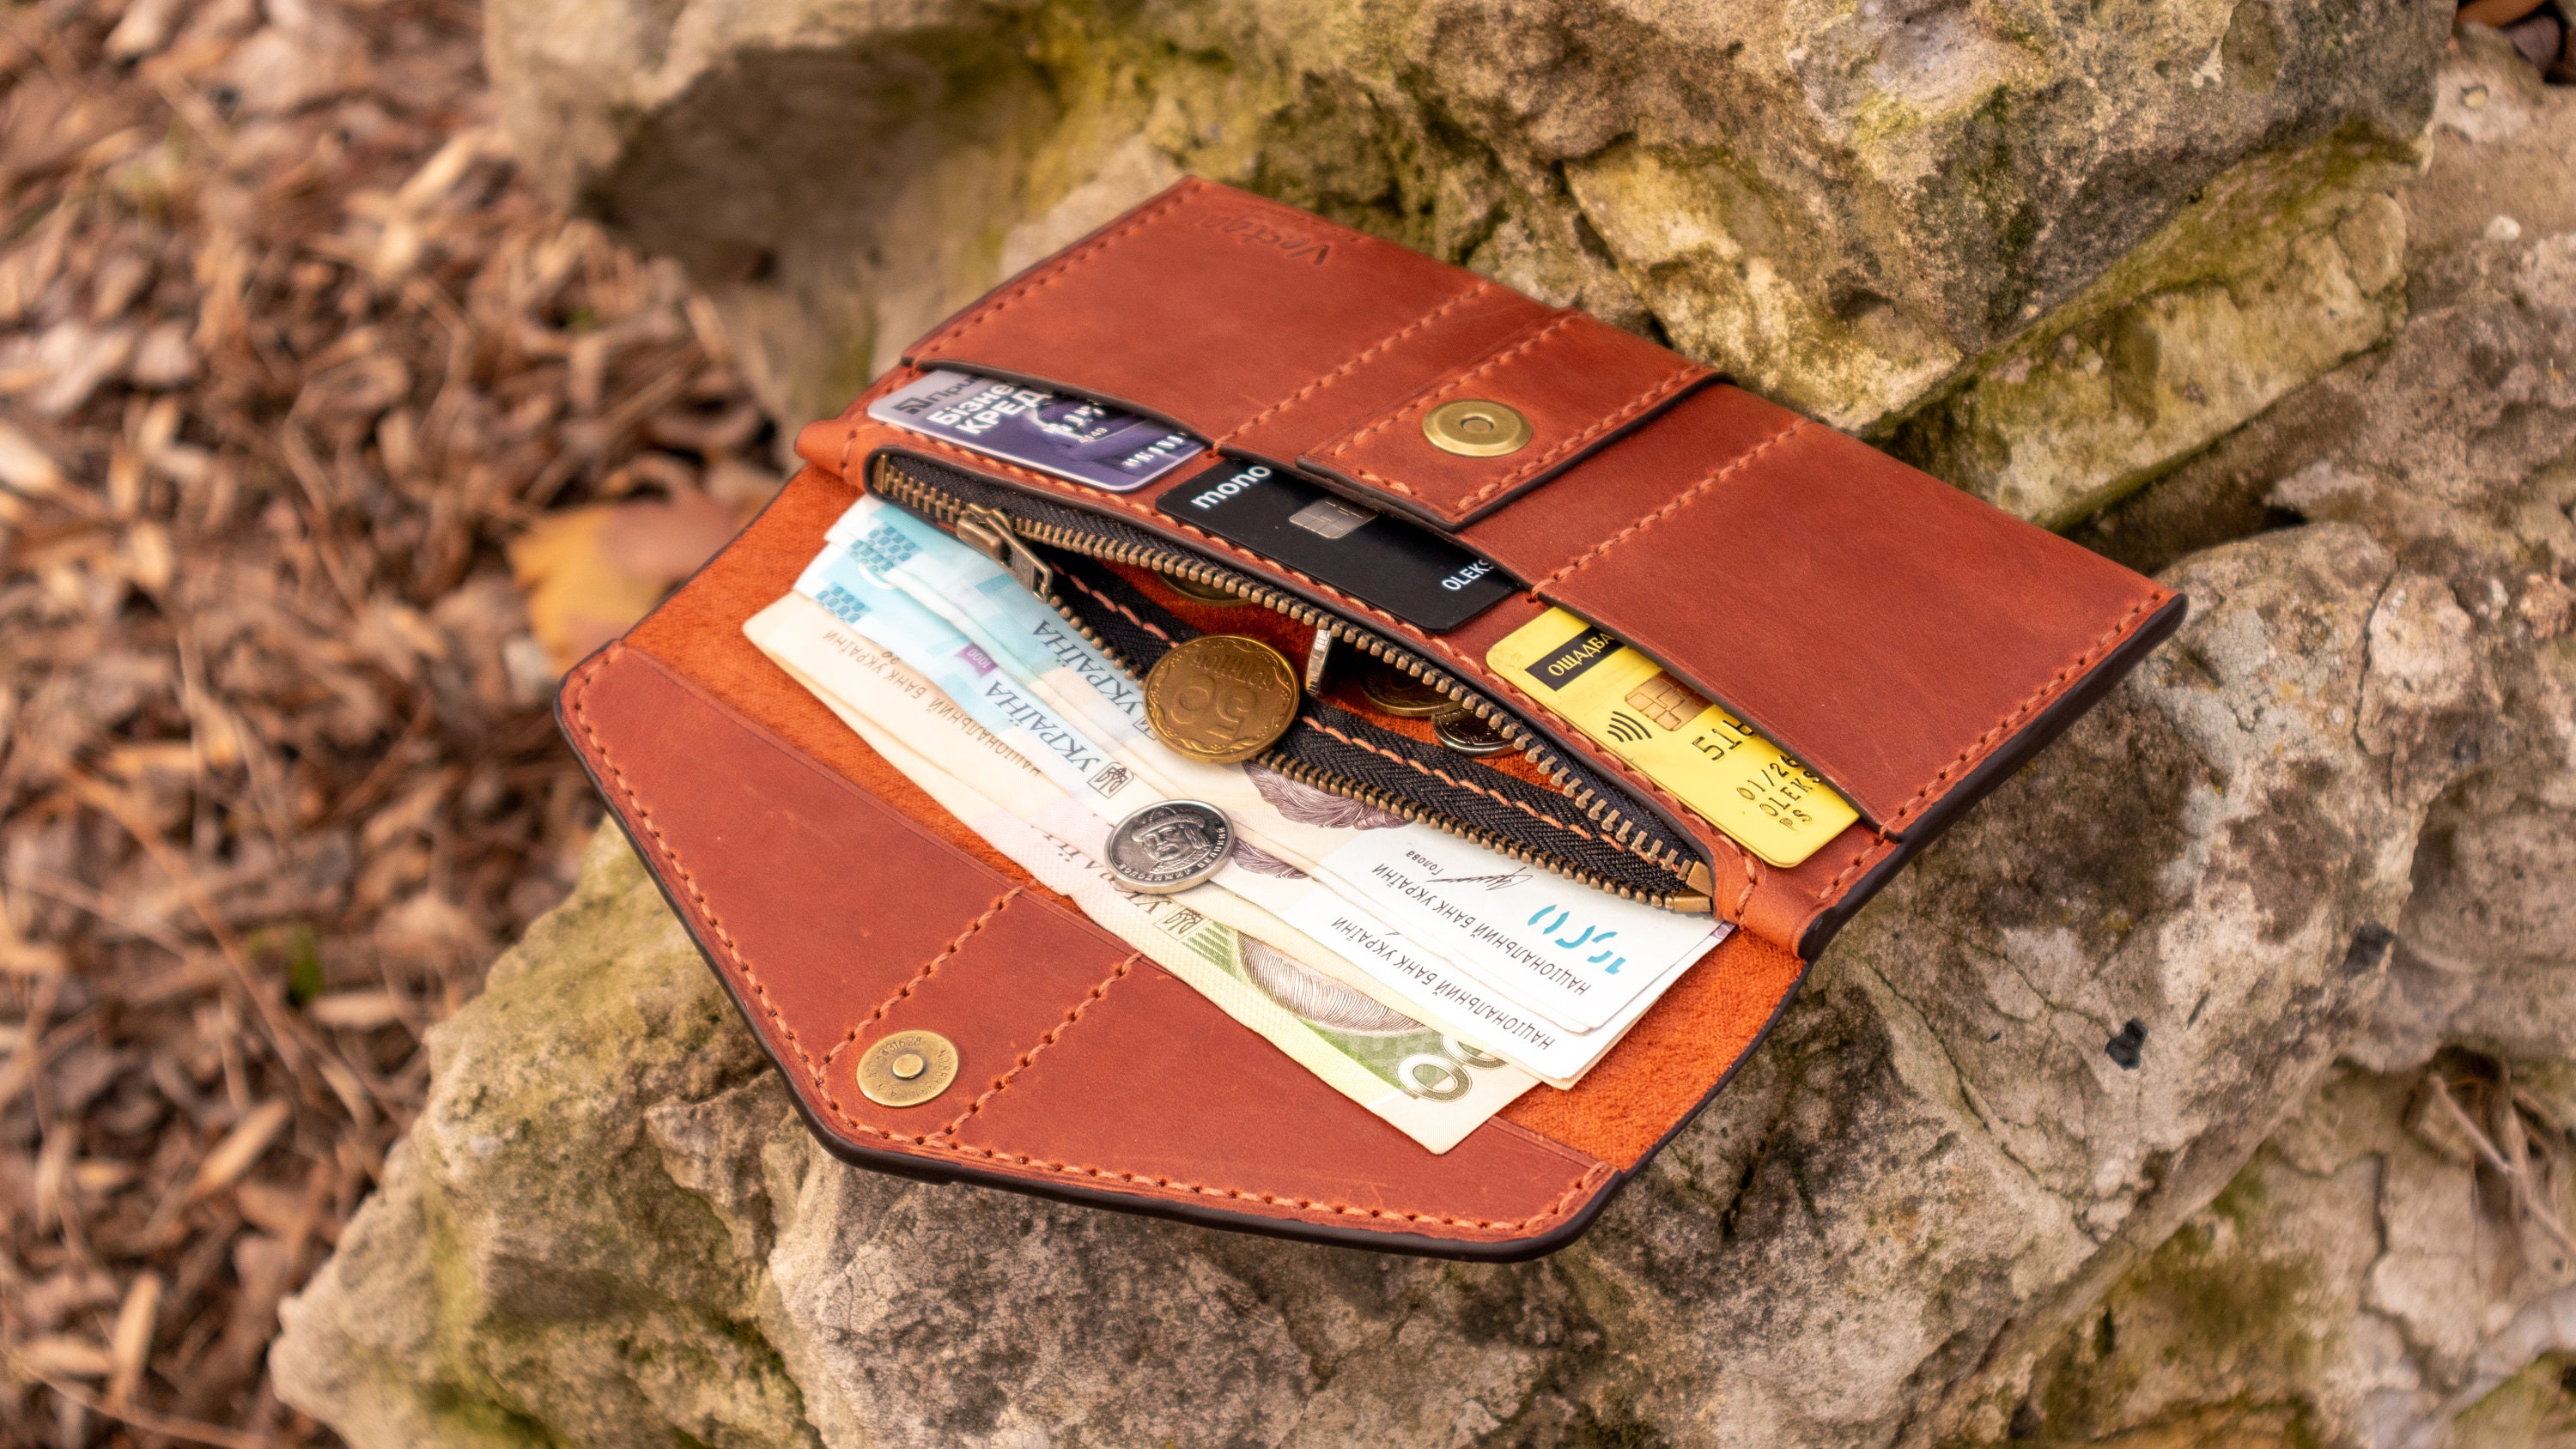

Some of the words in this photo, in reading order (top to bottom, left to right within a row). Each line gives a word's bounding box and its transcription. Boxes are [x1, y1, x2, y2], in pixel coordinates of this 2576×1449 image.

[955, 390, 1053, 434] КРЕД
[1191, 465, 1273, 509] mono
[1031, 620, 1143, 714] УКРАЇНА
[1548, 633, 1614, 676] ОЩАДБА
[984, 680, 1101, 773] УКРАЇНА
[1170, 671, 1259, 742] 50
[1759, 770, 1821, 816] OLEKS
[1372, 863, 1437, 906] УКРАЇНИ
[1406, 849, 1445, 876] Голова
[1432, 894, 1475, 929] БАНК
[1330, 915, 1399, 960] УКРАЇНИ
[1470, 921, 1592, 996] НАЦІОНАЛЬНИЙ
[1393, 951, 1437, 987] БАНК
[1432, 979, 1557, 1052] НАЦІОНАЛЬНИЙ
